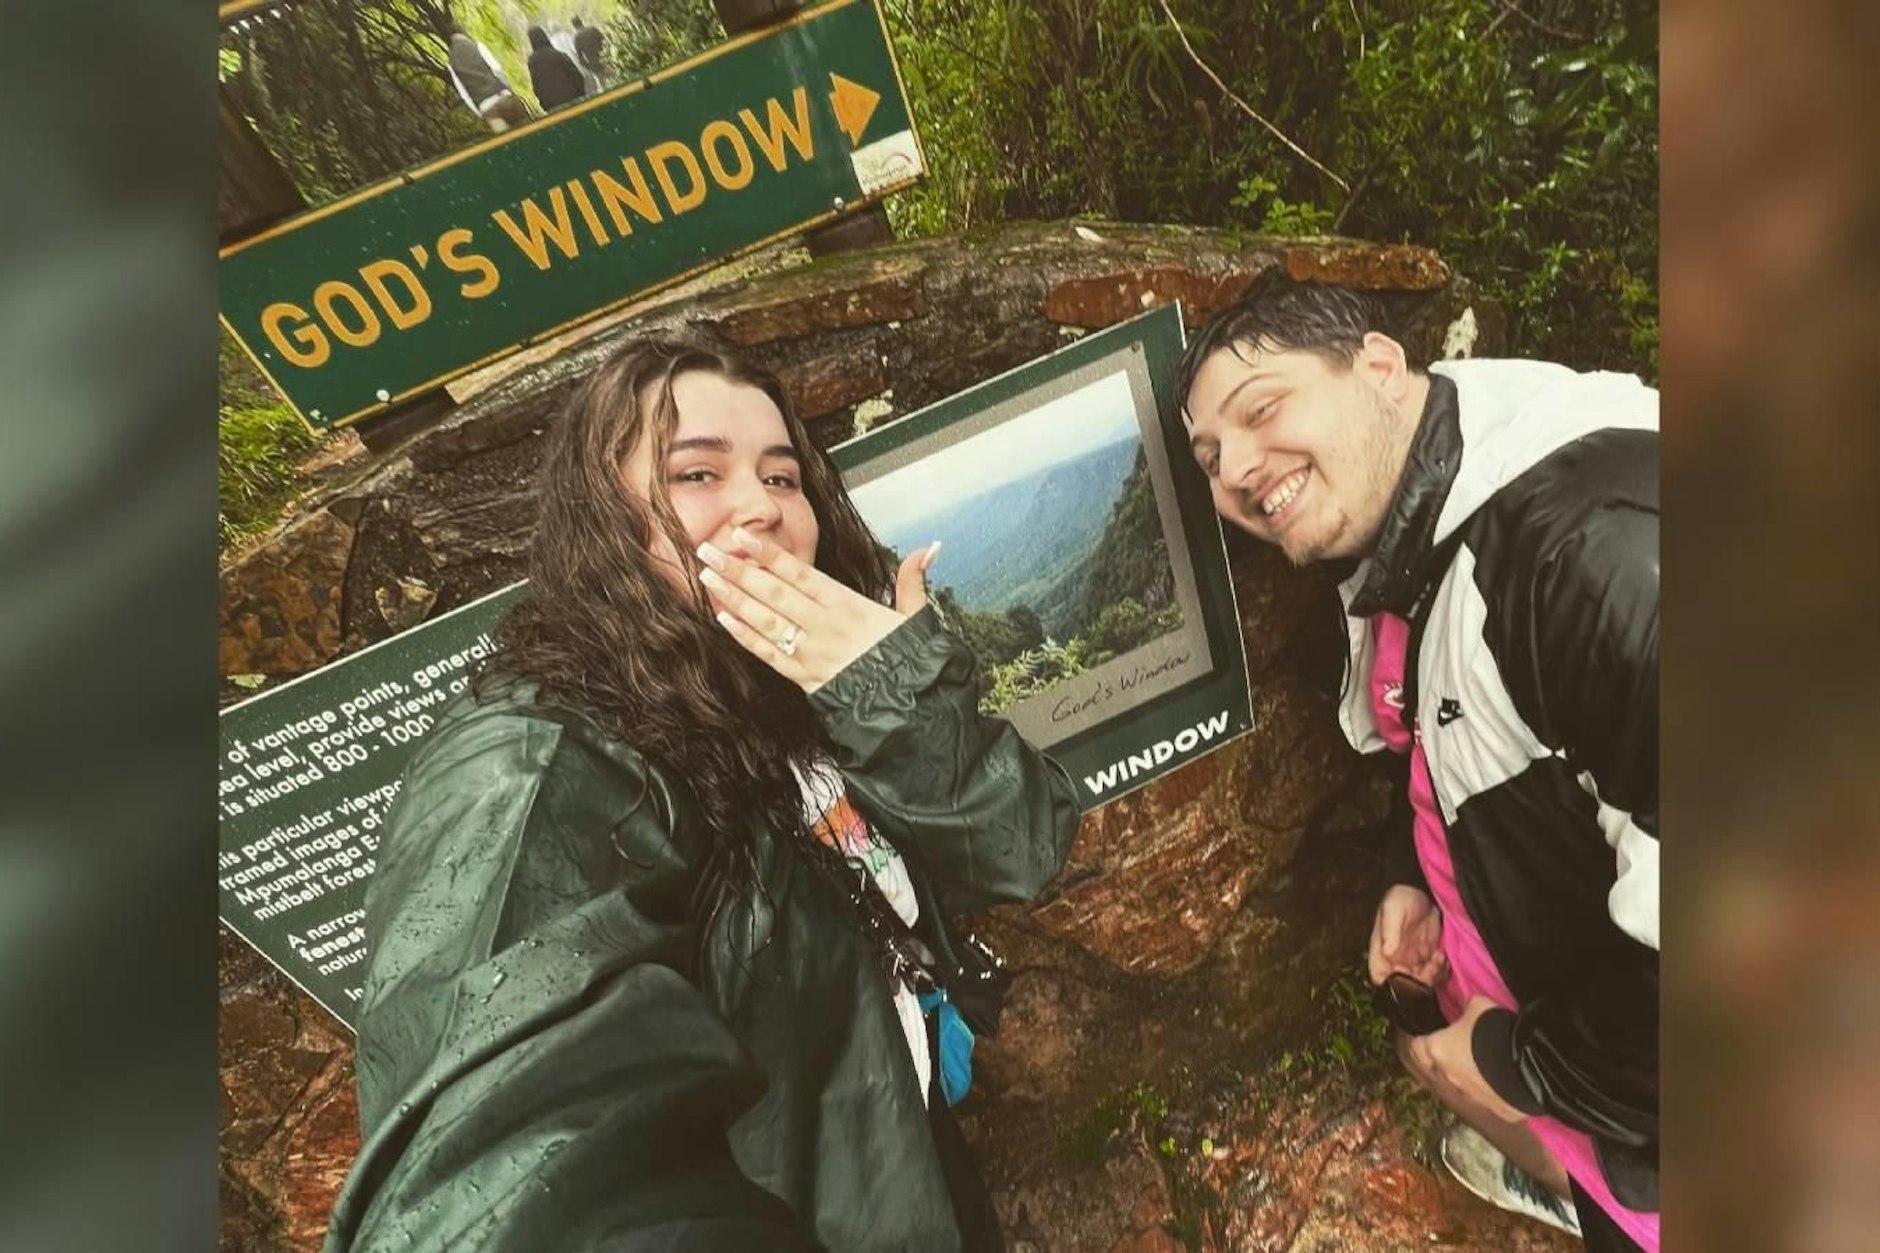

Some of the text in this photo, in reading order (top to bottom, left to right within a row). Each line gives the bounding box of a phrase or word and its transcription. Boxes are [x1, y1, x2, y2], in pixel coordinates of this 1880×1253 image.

[261, 87, 814, 369] GOD'S WINDOW
[227, 632, 499, 763] of vantage points, generall
[1051, 681, 1113, 723] God's
[243, 746, 307, 780] level,
[307, 713, 387, 760] provide
[387, 688, 447, 720] views
[1083, 709, 1229, 795] WINDOW
[219, 800, 245, 816] is
[245, 761, 324, 807] situated
[322, 743, 369, 772] 800
[241, 810, 334, 862] particular
[285, 825, 360, 860] images
[361, 808, 384, 829] of
[234, 845, 363, 906] Mpumalanga
[253, 881, 325, 920] mistbelt
[287, 933, 307, 949] A
